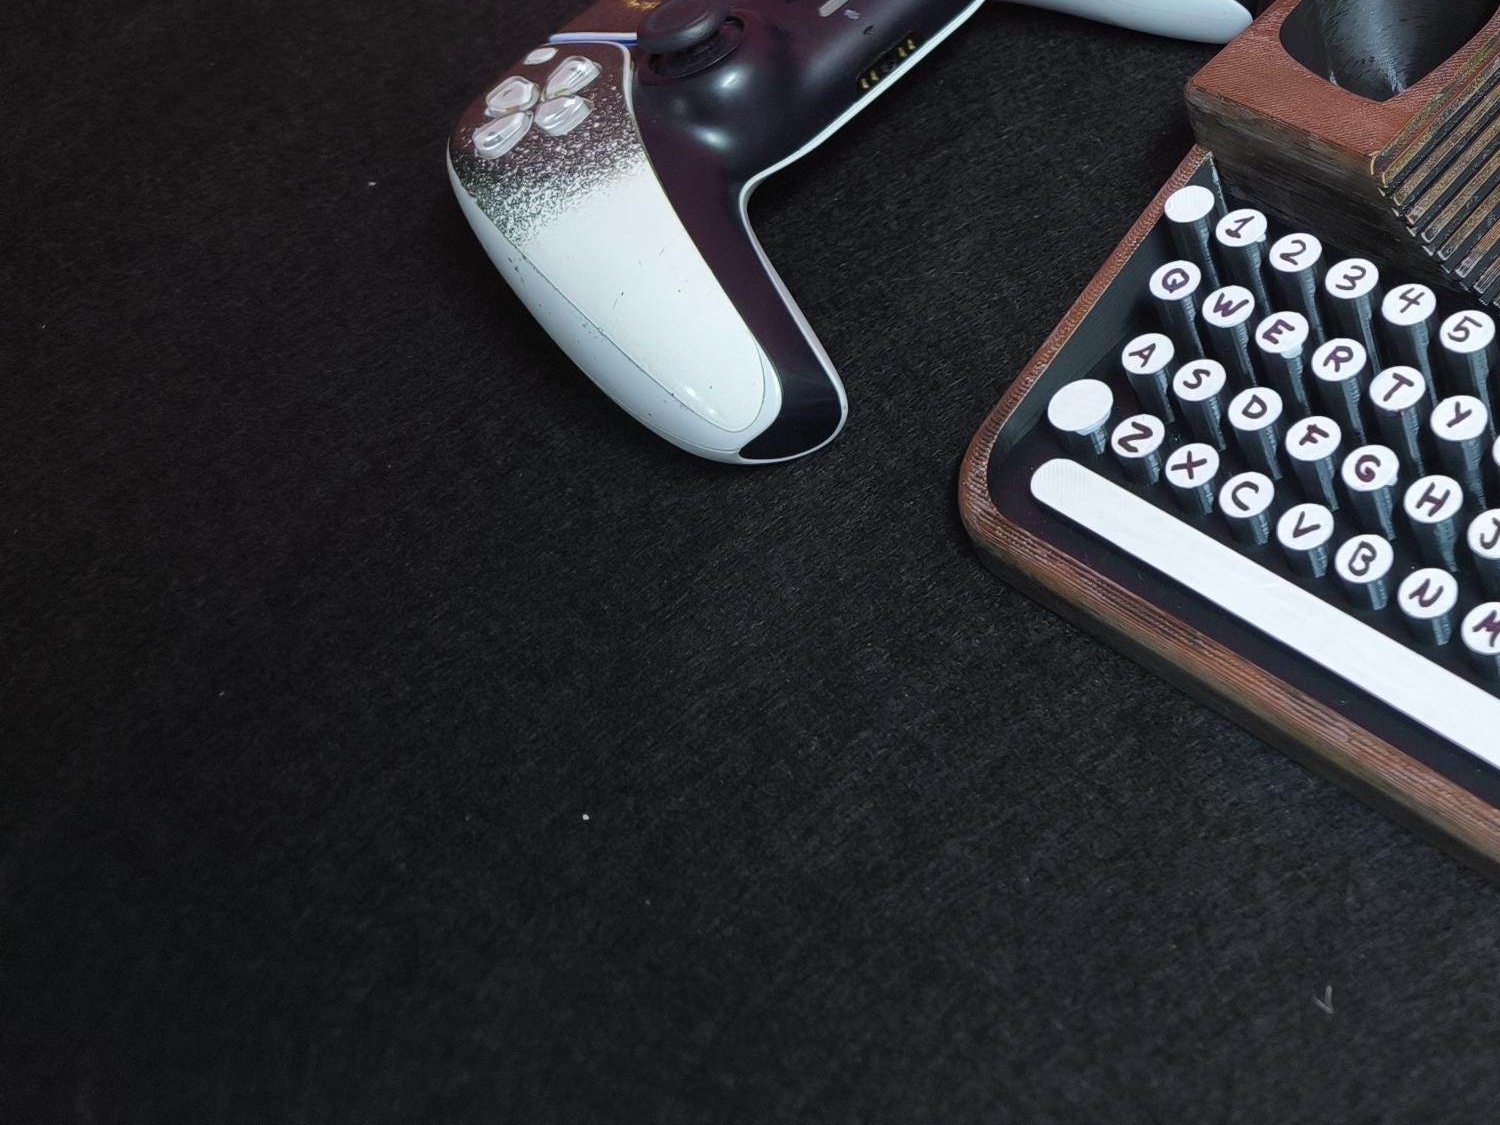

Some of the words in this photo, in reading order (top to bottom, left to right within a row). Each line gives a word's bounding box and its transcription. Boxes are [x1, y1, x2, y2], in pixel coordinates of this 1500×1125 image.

[1161, 267, 1190, 294] Q
[1212, 293, 1250, 318] W
[1262, 319, 1296, 345] E
[1322, 345, 1354, 373] R
[1383, 372, 1415, 402] T
[1446, 401, 1473, 428] Y
[1225, 215, 1255, 239] 1
[1279, 239, 1307, 266] 2
[1335, 265, 1367, 291] 3
[1399, 287, 1425, 314] 4
[1447, 315, 1483, 343] 5
[1128, 342, 1157, 368] A
[1182, 368, 1211, 390] S
[1241, 394, 1268, 420] D
[1298, 423, 1330, 446] F
[1354, 454, 1381, 483] G
[1415, 482, 1451, 518] H
[1117, 421, 1154, 453] Z
[1170, 450, 1208, 480] X
[1231, 480, 1260, 512] C
[1292, 511, 1321, 539] V
[1347, 540, 1377, 577] B
[1408, 578, 1444, 608] N
